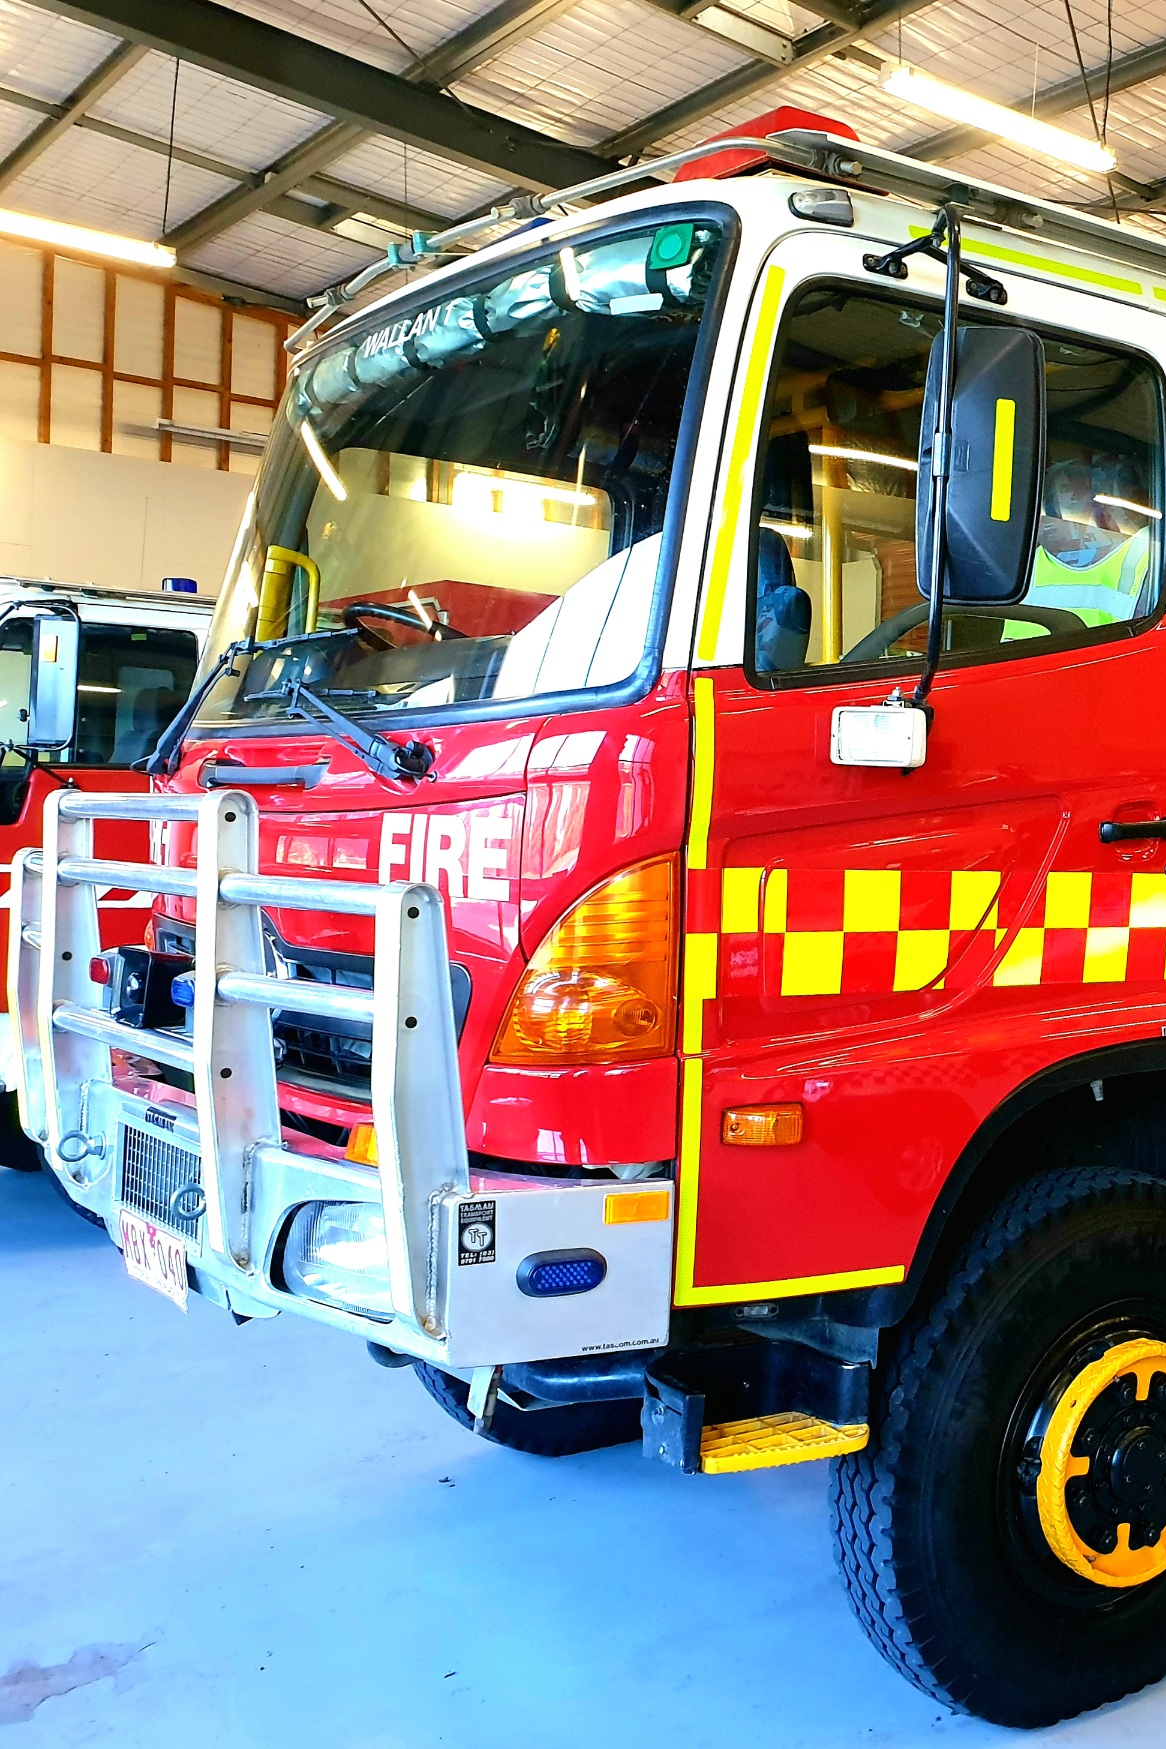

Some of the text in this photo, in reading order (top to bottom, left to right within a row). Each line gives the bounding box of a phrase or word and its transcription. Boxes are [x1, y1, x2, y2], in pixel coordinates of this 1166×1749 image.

[363, 299, 455, 358] WALLAN 1
[378, 813, 513, 902] FIRE
[460, 1202, 494, 1212] TASMAN
[460, 1210, 494, 1218] TRANSPORT
[460, 1216, 493, 1224] EQUIPMENT
